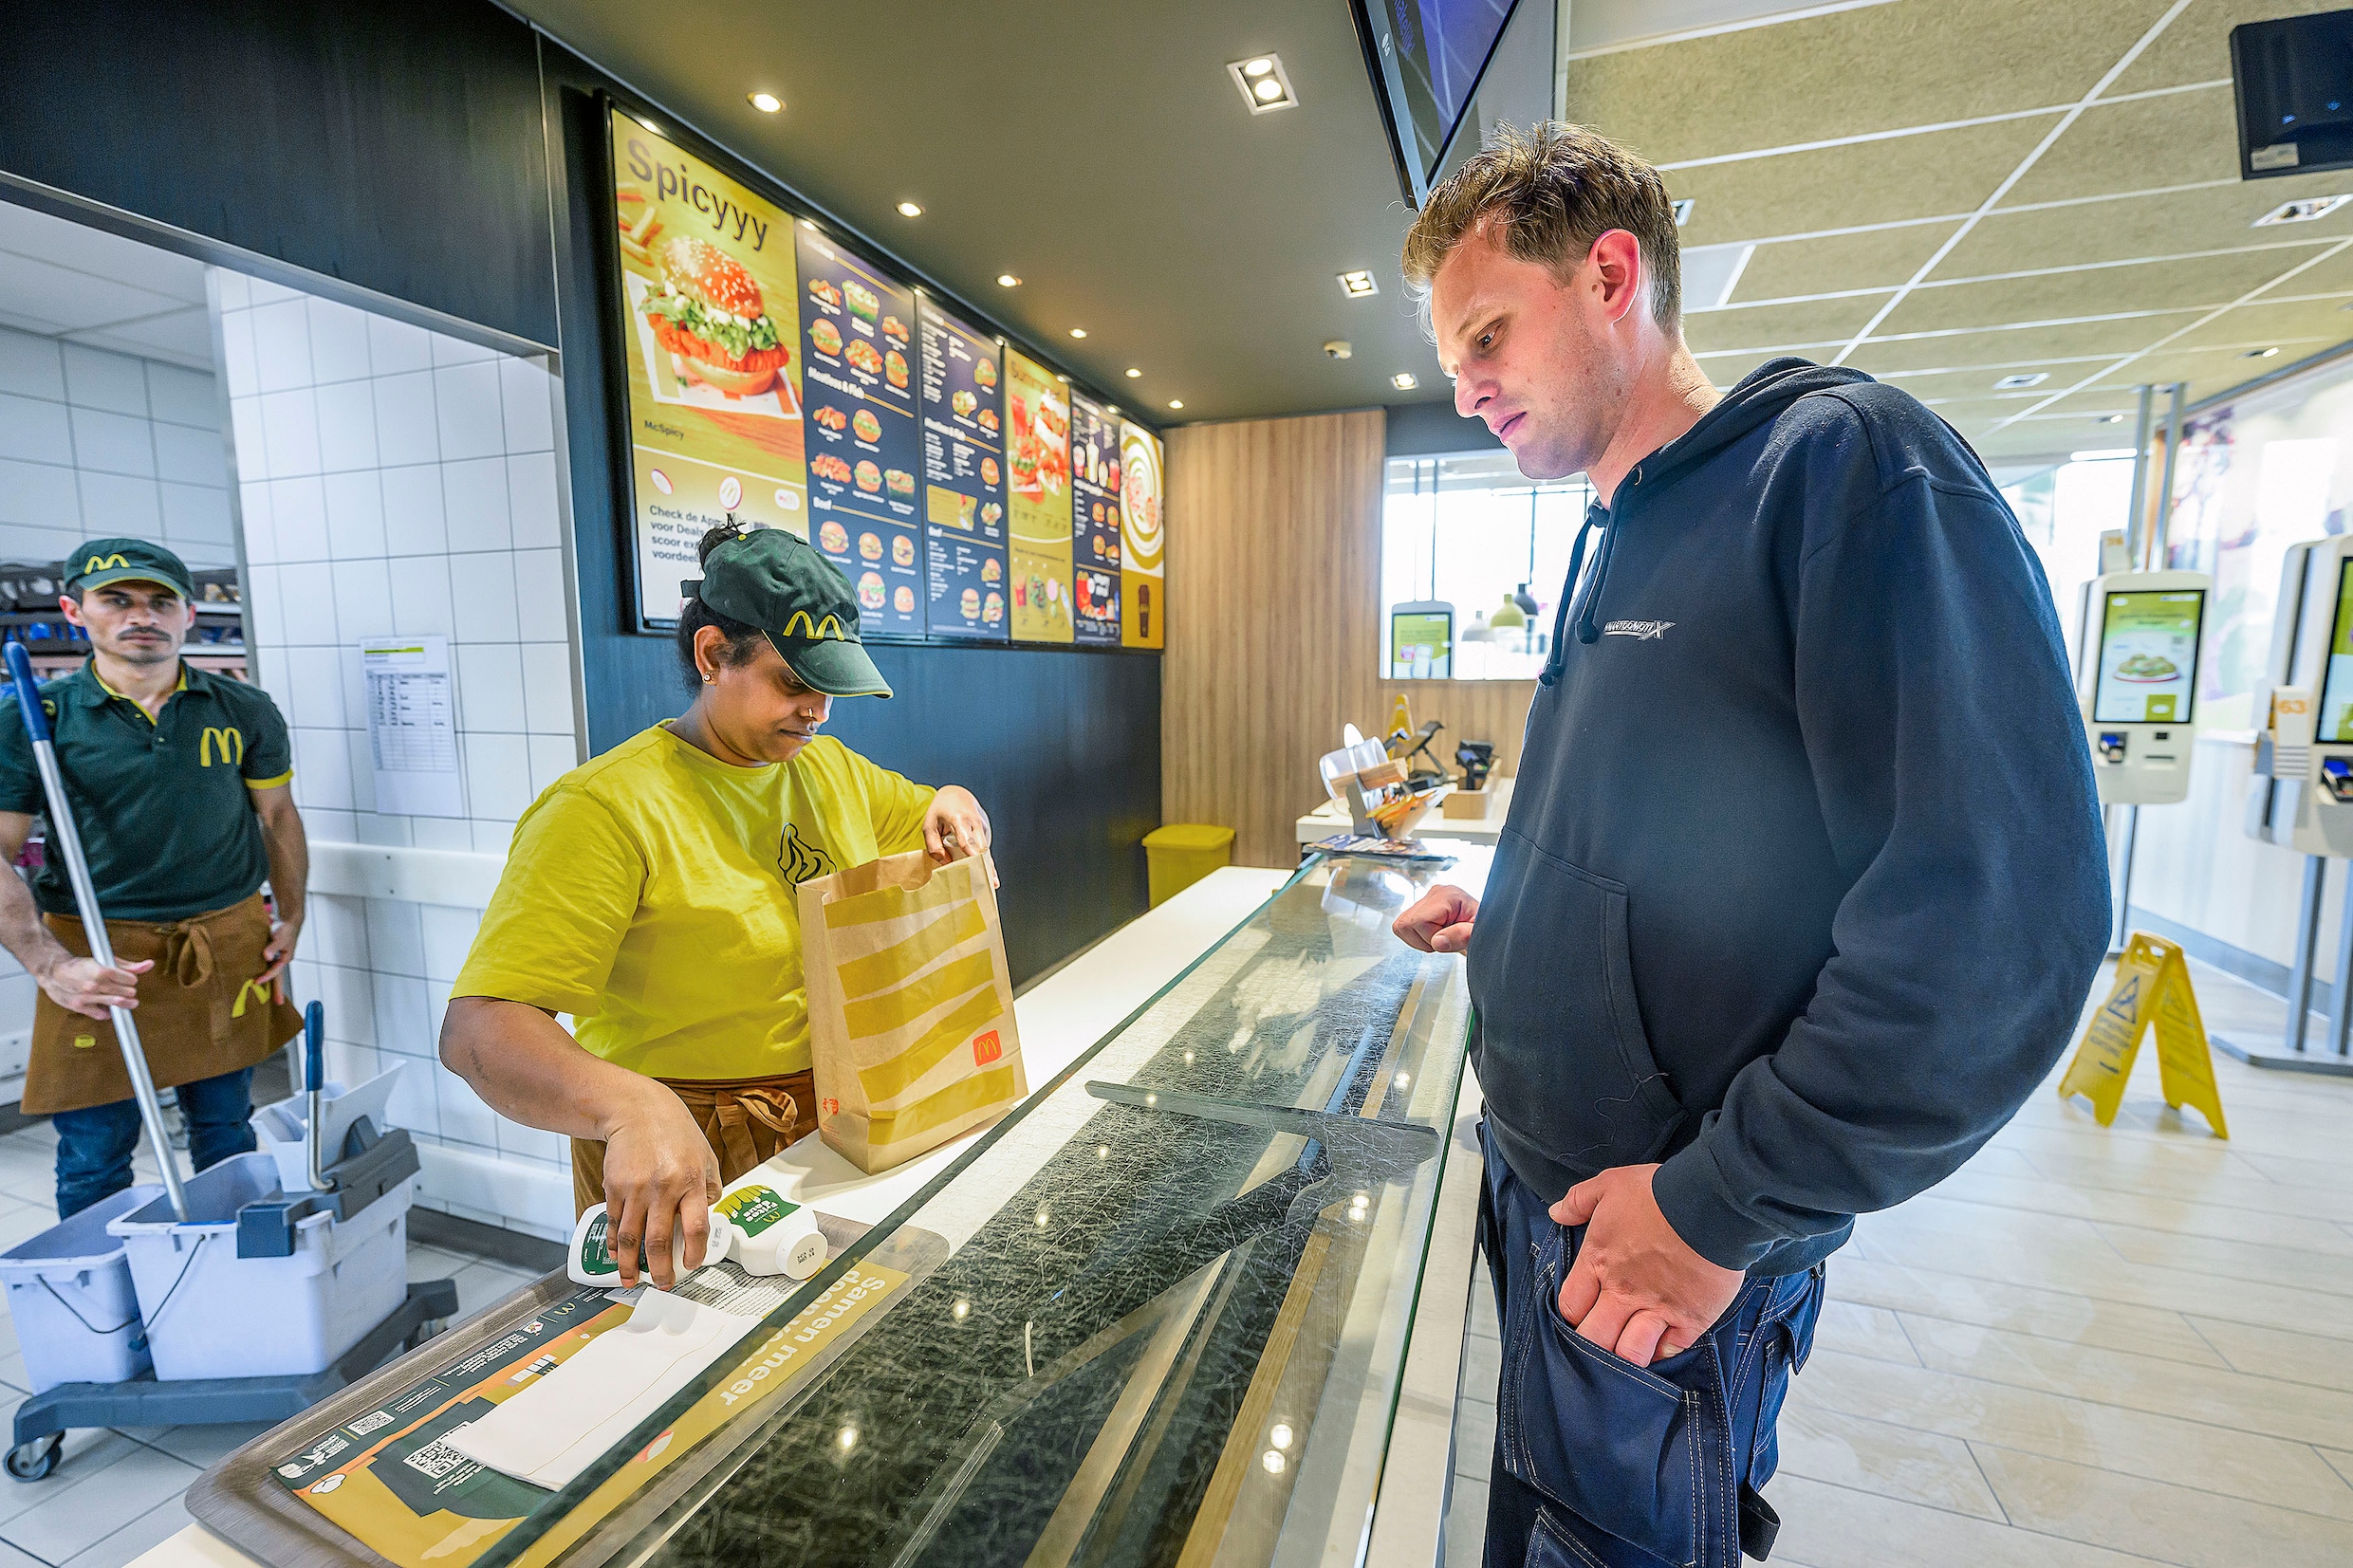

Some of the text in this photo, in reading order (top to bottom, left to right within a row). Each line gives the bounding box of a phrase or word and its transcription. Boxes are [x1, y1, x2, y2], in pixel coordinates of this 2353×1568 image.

[628, 138, 768, 251] Spicyyy
[644, 420, 684, 441] McSpicy
[649, 505, 683, 521] Check
[686, 510, 698, 523] de
[650, 522, 674, 532] voor
[652, 536, 681, 547] scoor
[794, 1277, 886, 1343] Samen
[719, 1344, 798, 1407] meer
